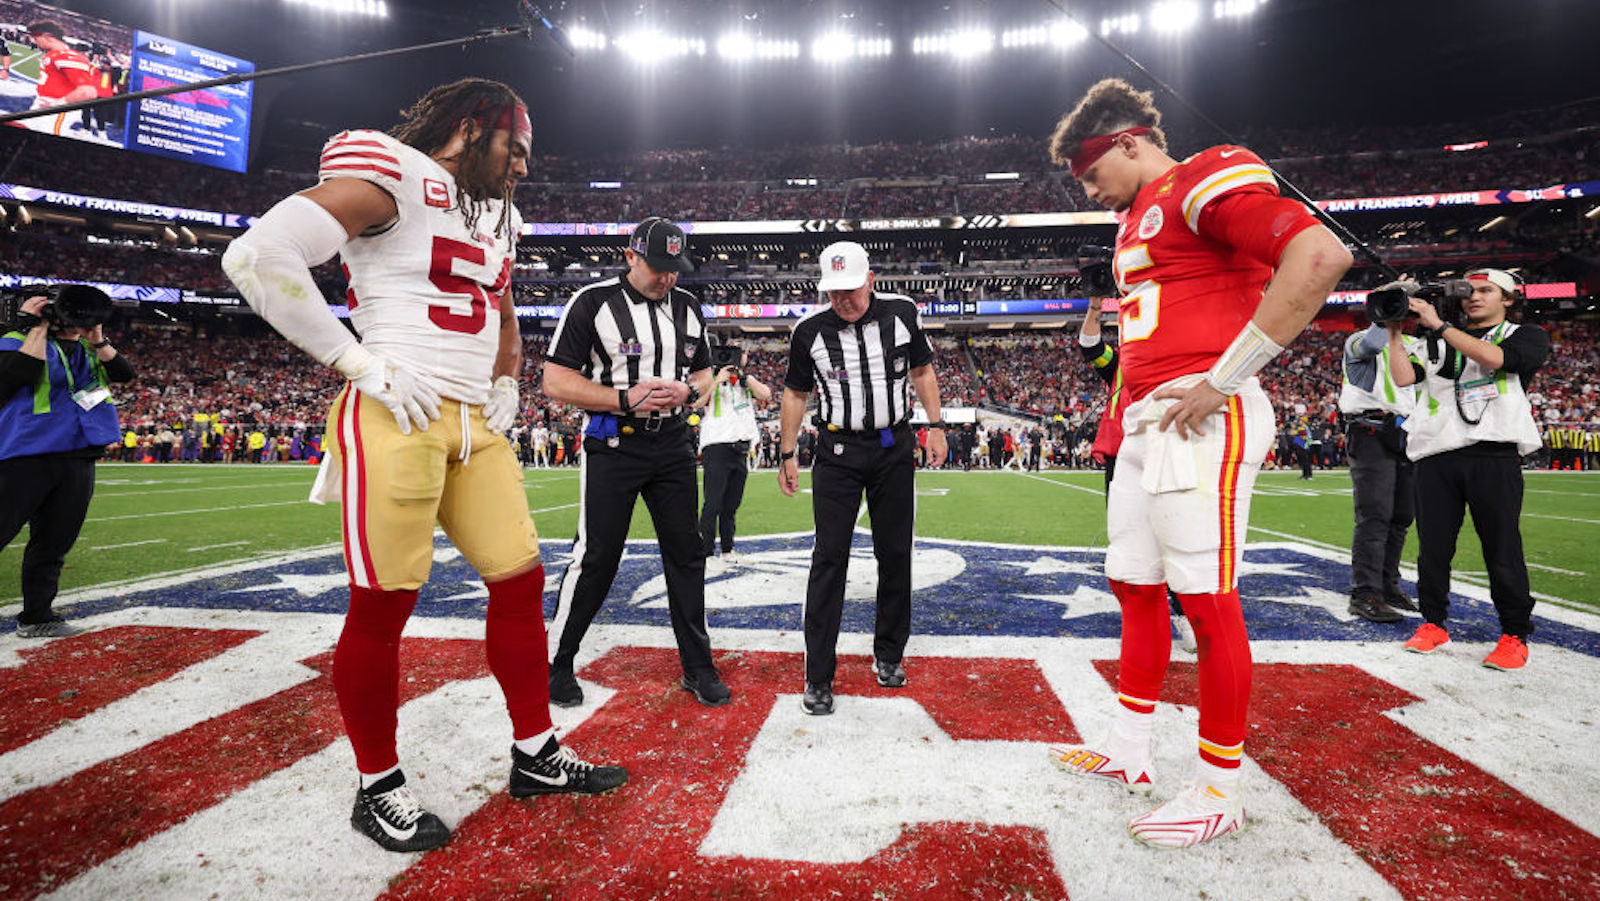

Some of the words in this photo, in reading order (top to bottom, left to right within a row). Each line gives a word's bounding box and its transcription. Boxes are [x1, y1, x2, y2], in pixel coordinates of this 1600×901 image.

[425, 181, 448, 200] C
[45, 191, 83, 208] SAN
[86, 197, 174, 218] FRANCISCO
[178, 208, 223, 225] 49ERS
[1328, 201, 1356, 212] SAN
[1358, 196, 1435, 210] FRANCISCO
[1438, 192, 1480, 205] 49ERS
[861, 220, 890, 229] SUPER
[893, 219, 920, 228] BOWL
[1113, 242, 1162, 343] 5
[513, 307, 539, 317] OWL
